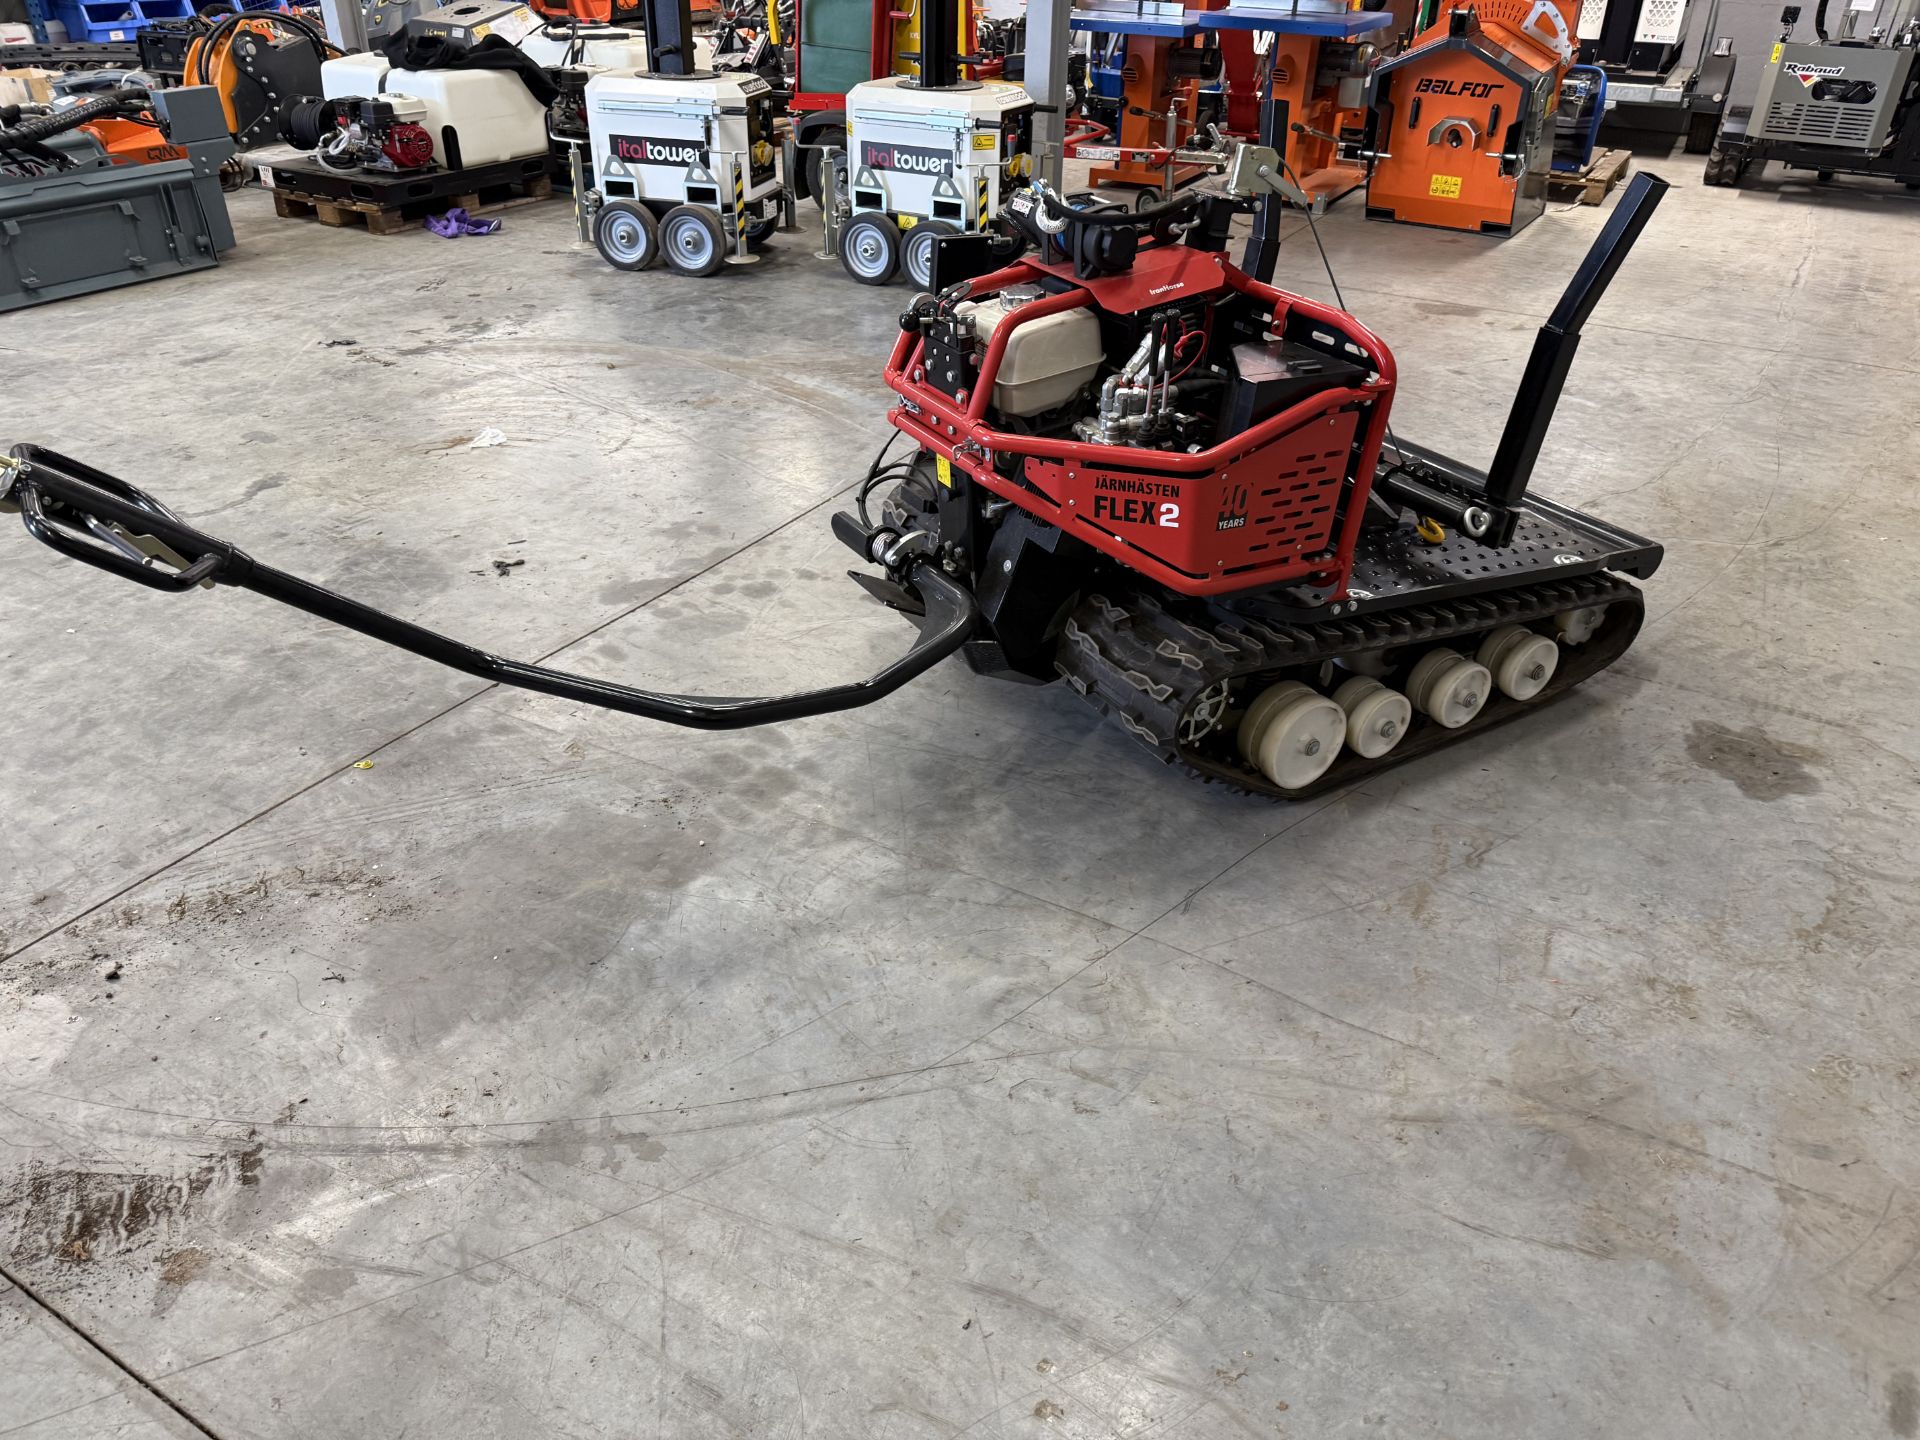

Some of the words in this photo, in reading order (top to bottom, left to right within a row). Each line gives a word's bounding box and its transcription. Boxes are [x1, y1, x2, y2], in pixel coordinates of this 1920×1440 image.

[1785, 63, 1843, 75] Rabaud
[618, 138, 702, 163] italtower
[867, 145, 950, 174] italtower
[1149, 282, 1184, 295] IronHorse
[1095, 474, 1180, 498] JÄRNHÄSTEN
[1218, 517, 1245, 530] YEARS
